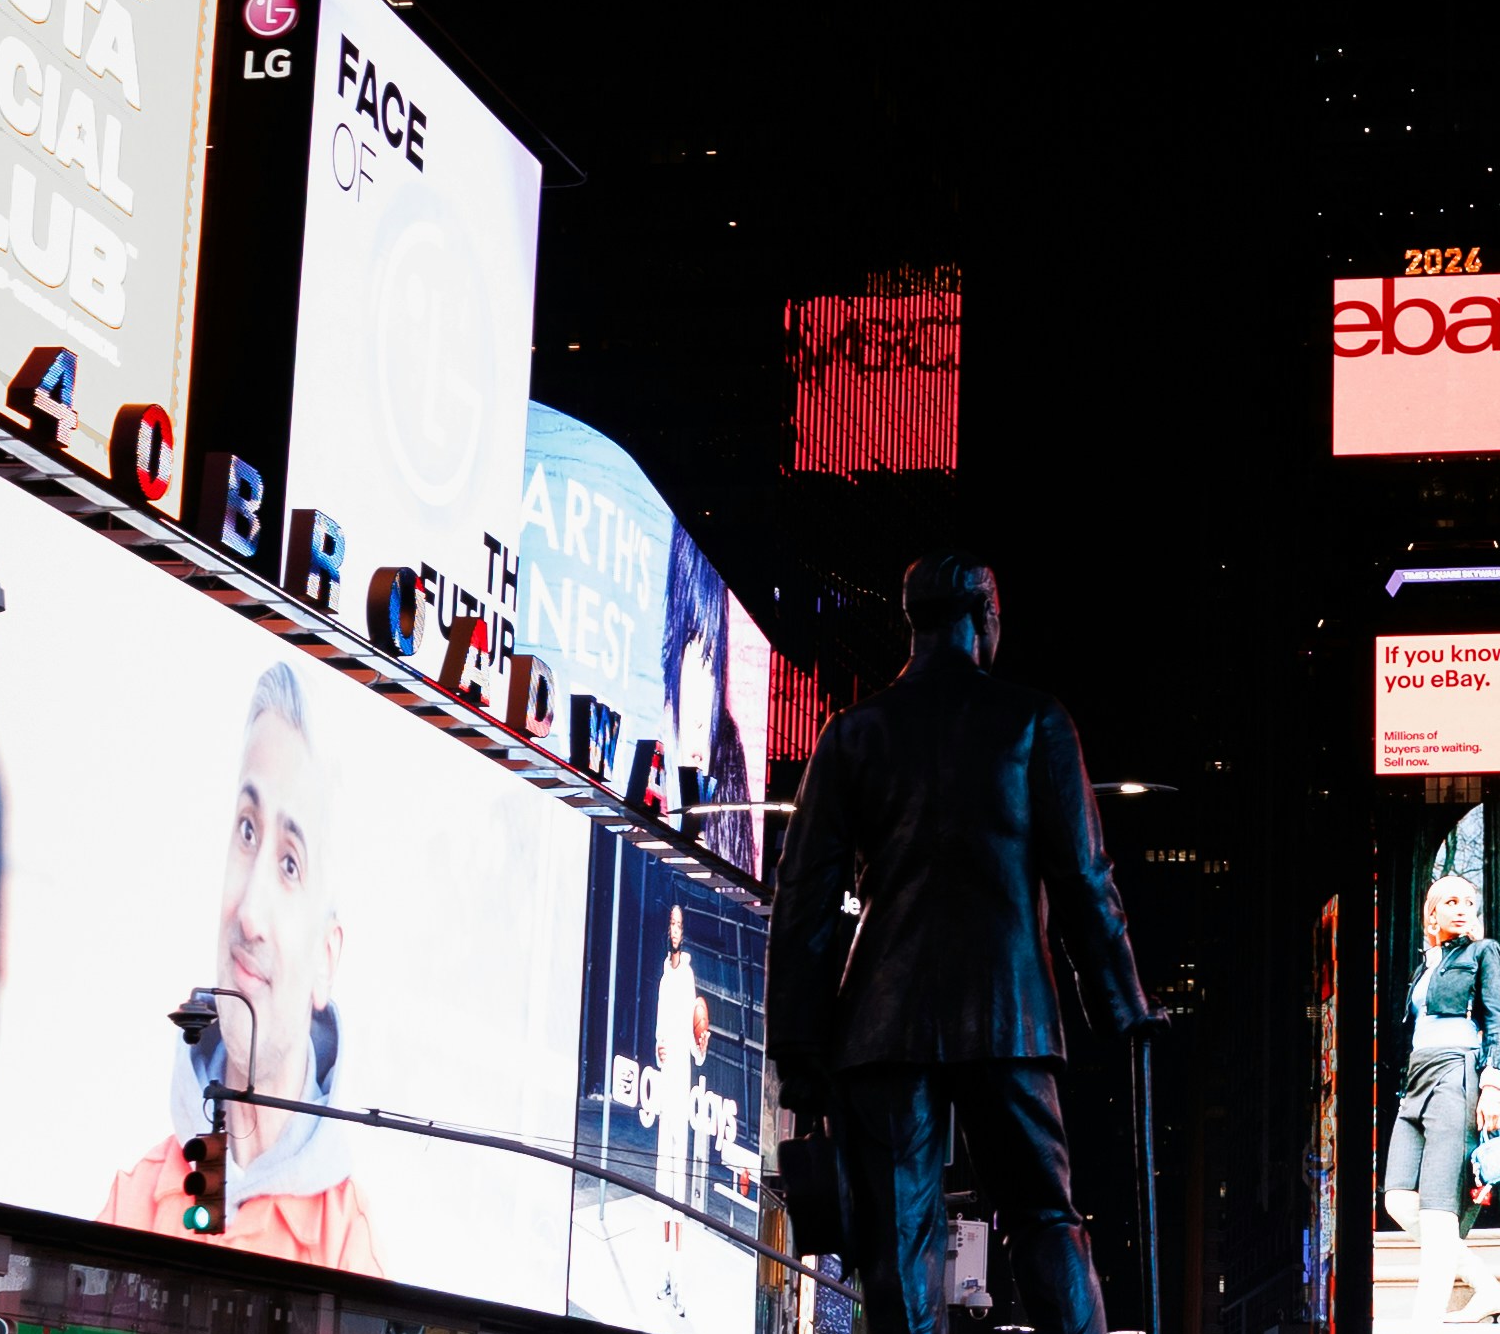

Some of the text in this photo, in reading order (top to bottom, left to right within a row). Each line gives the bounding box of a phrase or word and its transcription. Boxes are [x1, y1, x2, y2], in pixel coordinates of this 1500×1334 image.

[244, 50, 291, 79] LG
[337, 34, 426, 173] FACE
[333, 123, 376, 201] OF
[521, 463, 652, 611] ARTH'S
[530, 562, 634, 689] NEST
[1385, 646, 1399, 664] If
[1404, 649, 1444, 667] you
[1385, 670, 1490, 692] you eBay.
[1384, 731, 1438, 741] Millions of
[1384, 742, 1482, 755] buyers are waiting.
[1384, 758, 1430, 767] Sell now.
